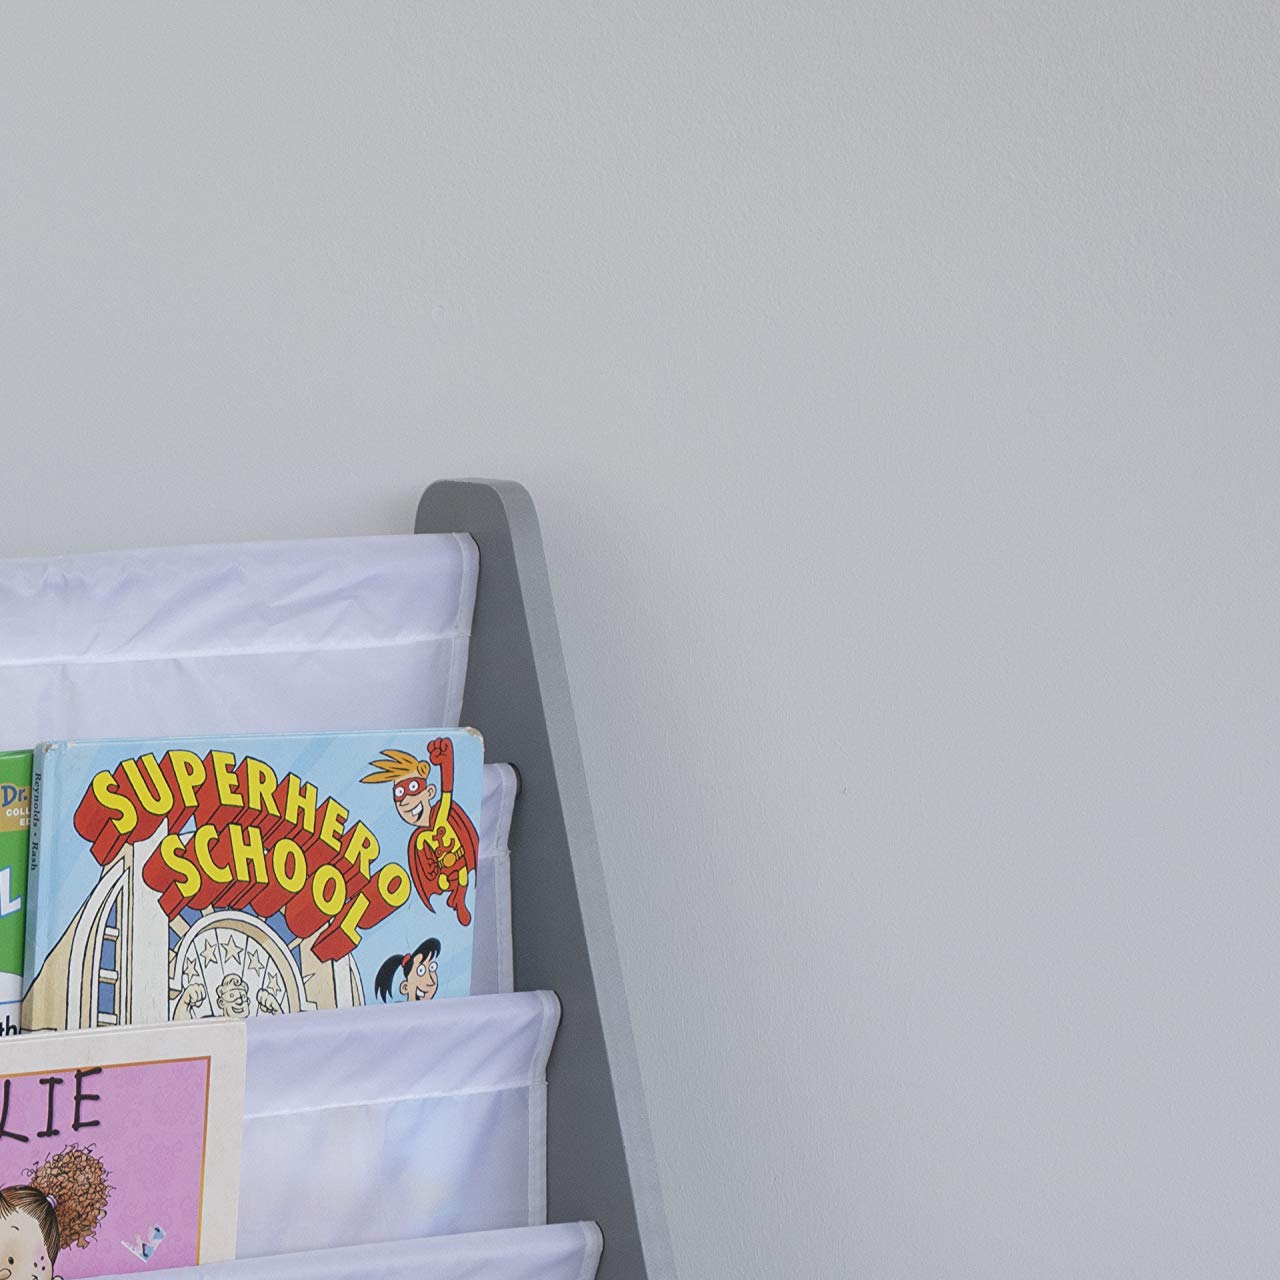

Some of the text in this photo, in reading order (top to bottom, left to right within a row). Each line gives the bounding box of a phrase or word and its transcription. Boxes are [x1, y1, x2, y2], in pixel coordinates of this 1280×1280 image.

[0, 784, 28, 807] Dr.
[5, 807, 31, 817] COLL
[30, 773, 42, 871] Reynolds Rash
[90, 749, 412, 908] SUPERHERO
[156, 822, 370, 945] SCHOOL
